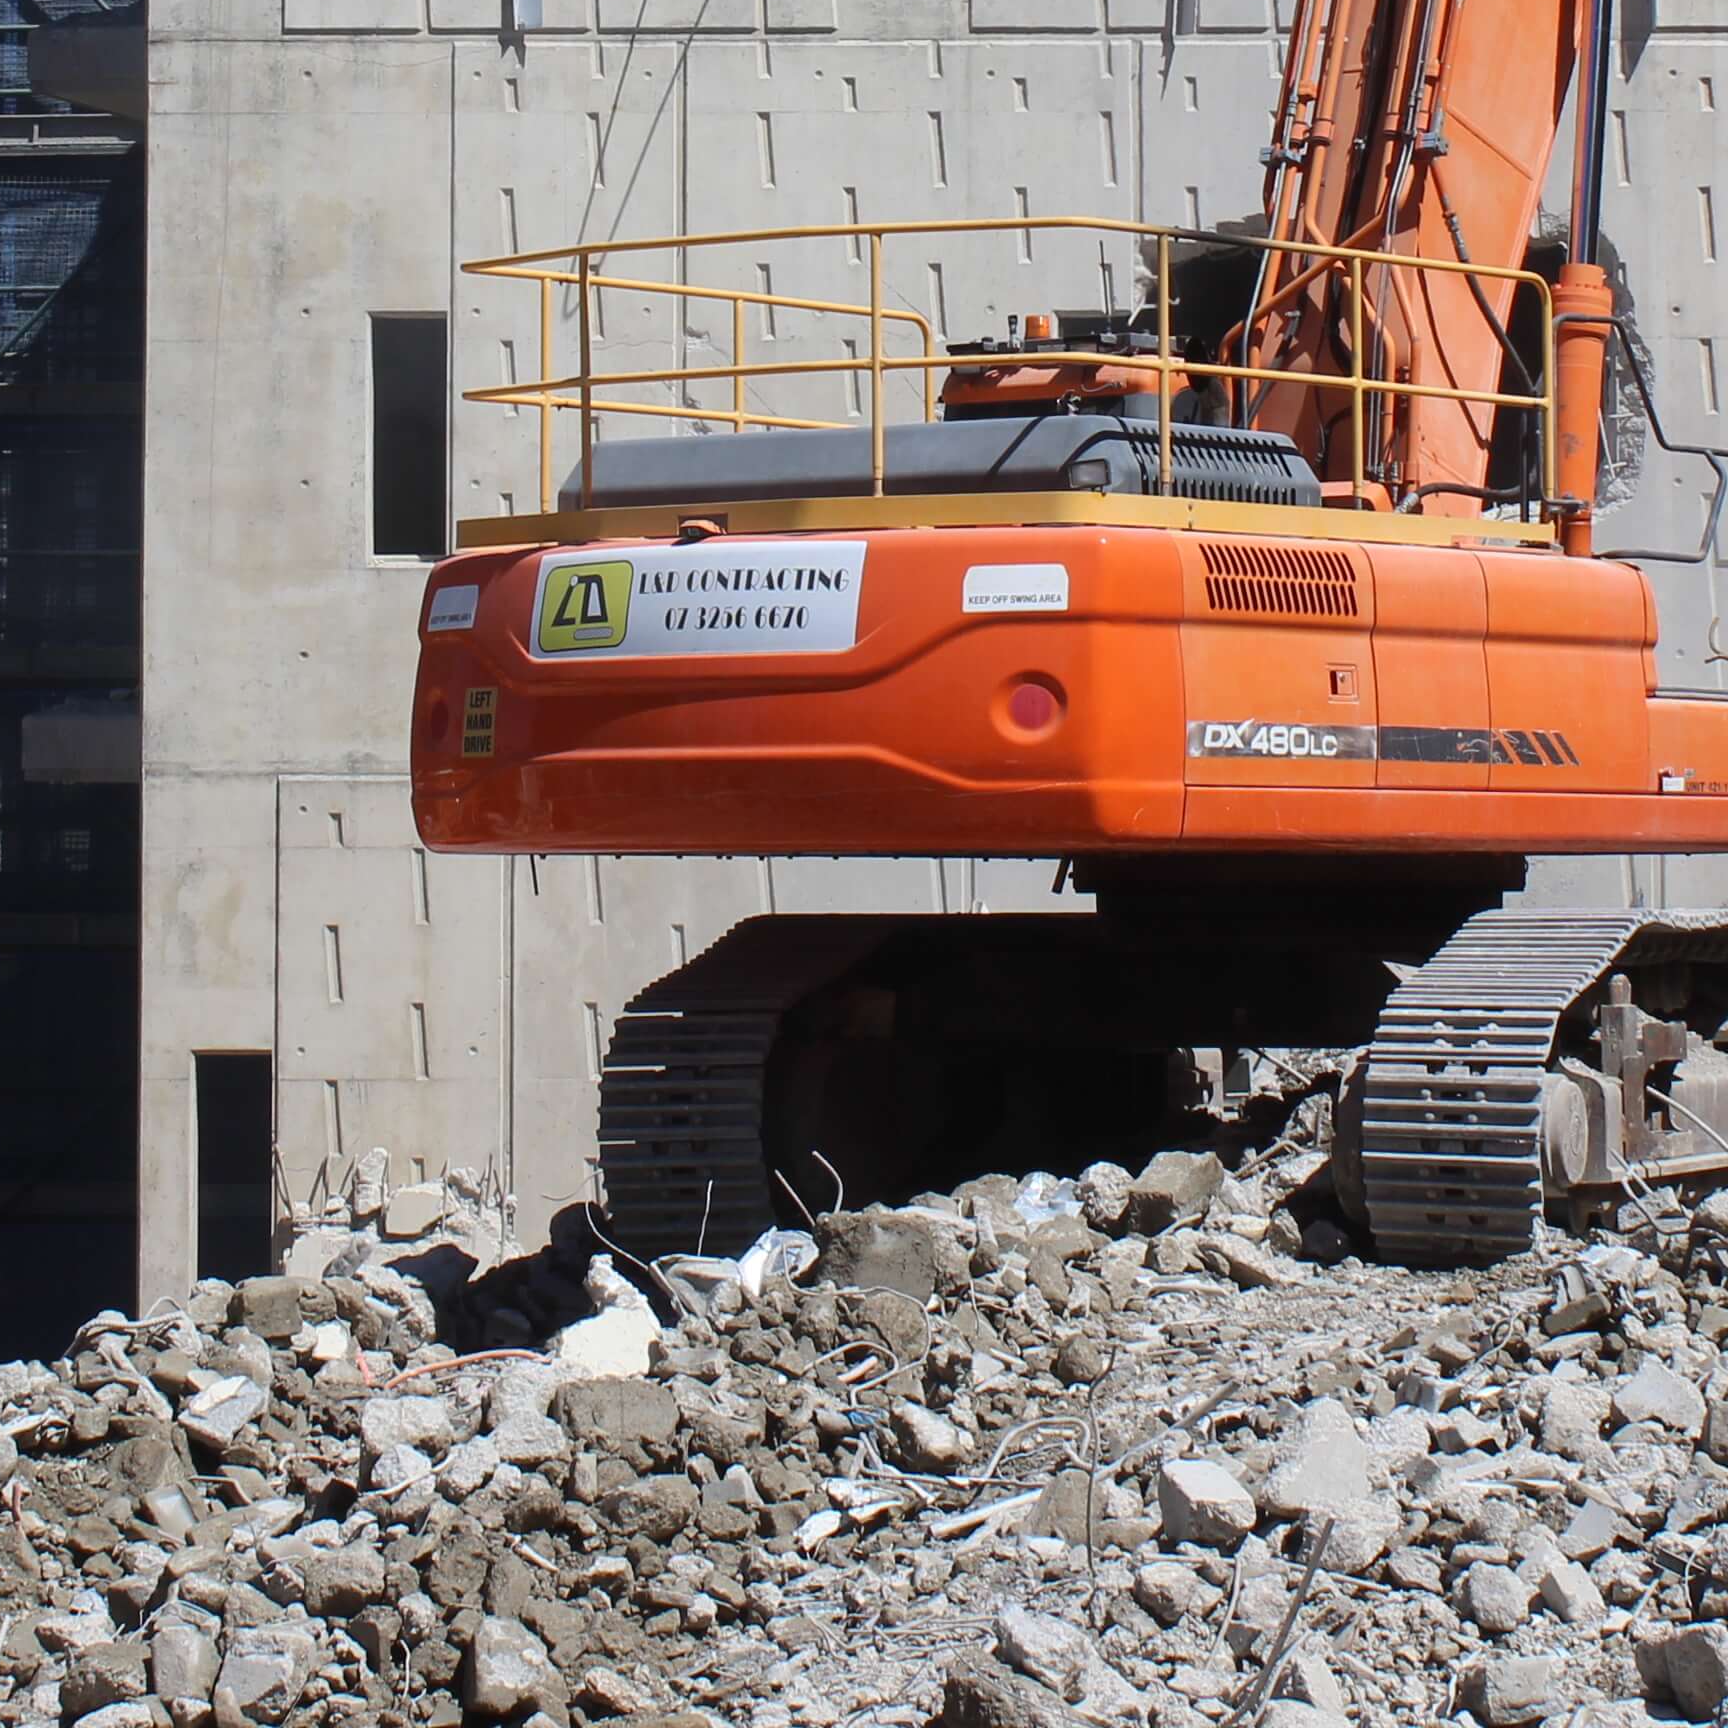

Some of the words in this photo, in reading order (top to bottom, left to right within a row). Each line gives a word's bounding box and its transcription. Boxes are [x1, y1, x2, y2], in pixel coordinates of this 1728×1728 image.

[639, 571, 680, 594] L&D
[687, 568, 850, 592] CONTRACTING
[968, 595, 991, 605] KEEP
[992, 595, 1009, 604] OFF
[1010, 594, 1038, 604] SWING
[1039, 593, 1063, 603] AREA
[665, 607, 689, 631] 07
[694, 605, 747, 630] 3256
[754, 605, 810, 630] 6670
[469, 690, 492, 708] LEFT
[466, 713, 492, 730] HAND
[464, 735, 492, 753] DRIVE
[1204, 718, 1255, 749] DX
[1251, 725, 1337, 757] 480LC
